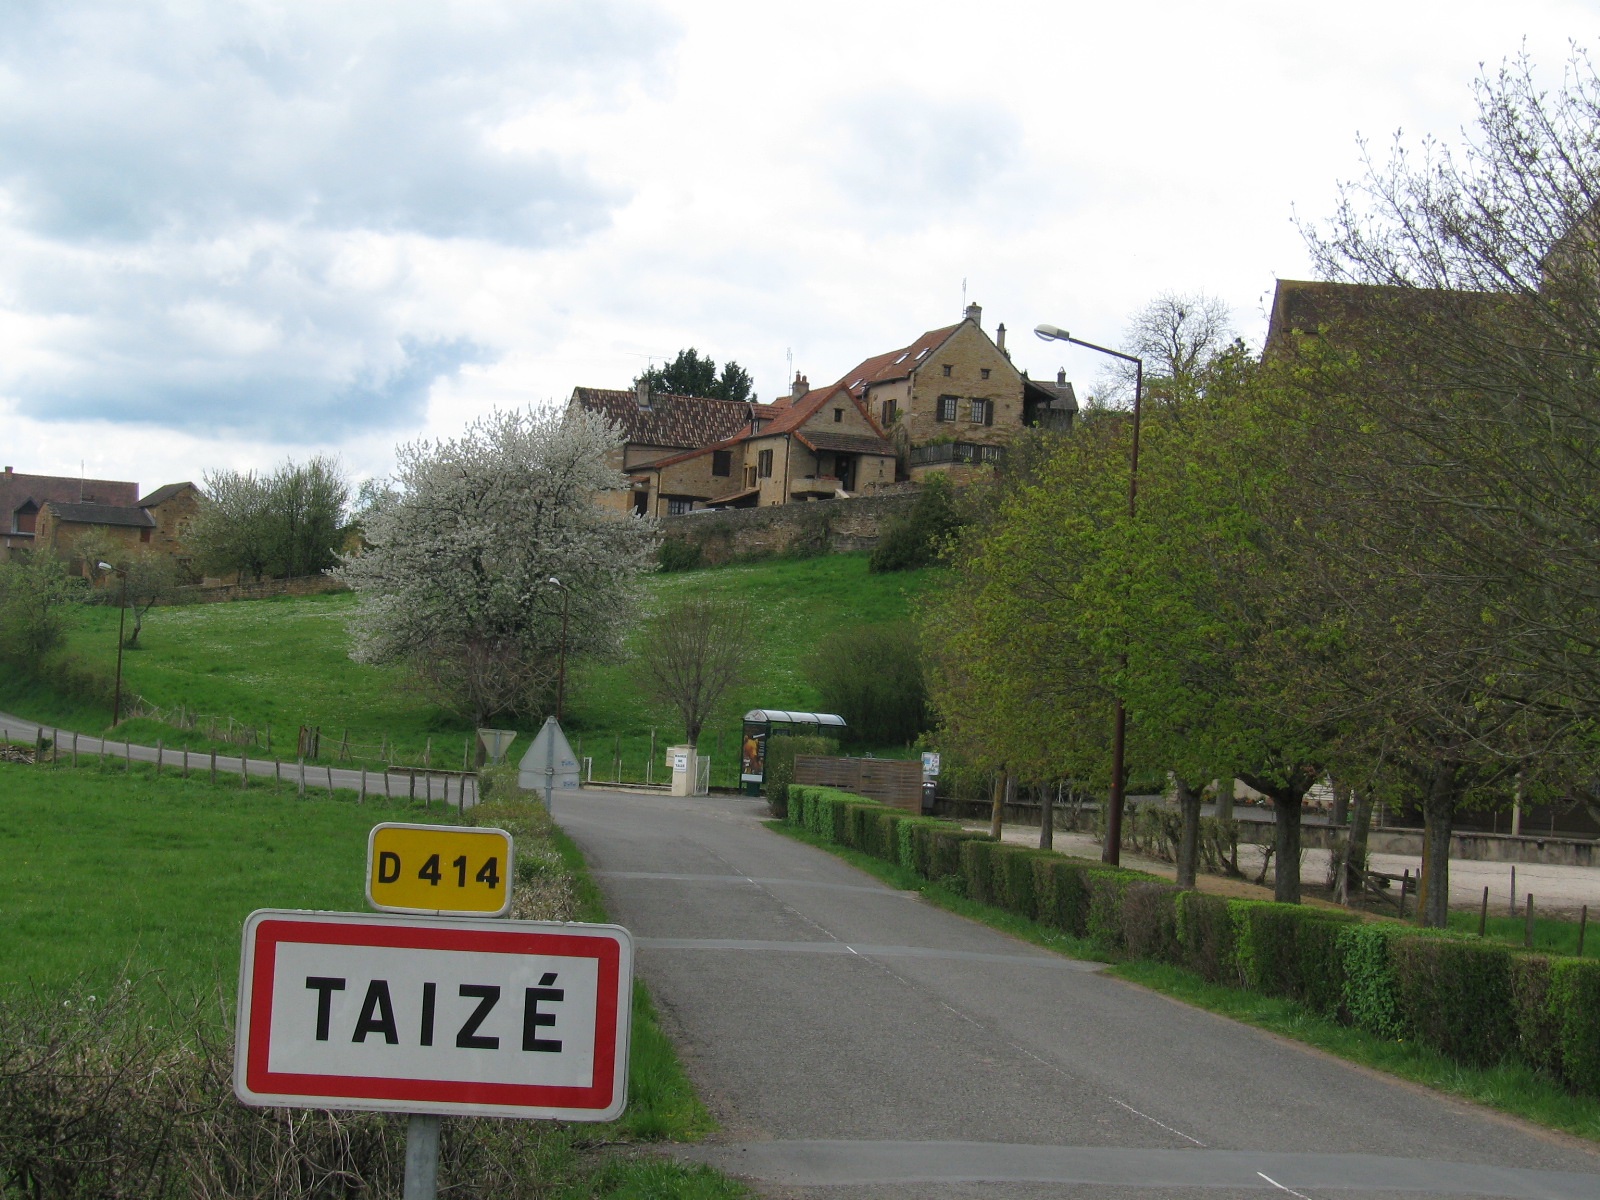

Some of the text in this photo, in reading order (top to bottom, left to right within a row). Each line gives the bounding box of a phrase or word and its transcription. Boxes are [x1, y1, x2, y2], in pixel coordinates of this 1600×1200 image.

[377, 852, 500, 889] D 414
[305, 973, 565, 1053] TAIZÉ
